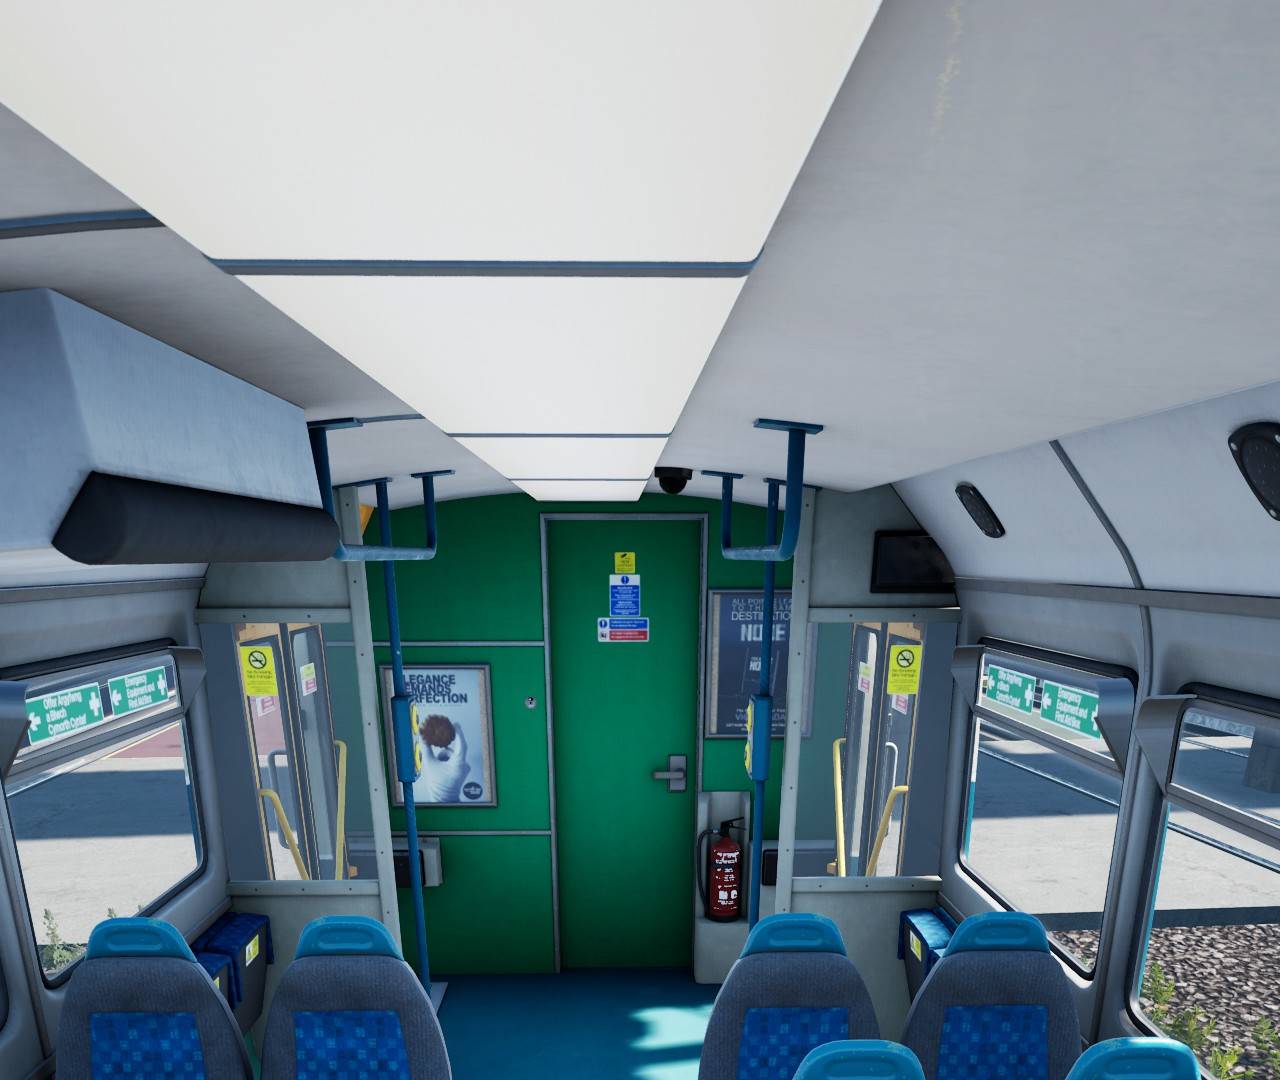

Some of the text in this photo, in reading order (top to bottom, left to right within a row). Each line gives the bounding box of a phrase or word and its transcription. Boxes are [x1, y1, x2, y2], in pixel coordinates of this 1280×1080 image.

[741, 623, 786, 641] NOE
[403, 674, 456, 685] LEGANCE
[404, 682, 452, 694] EMANDS
